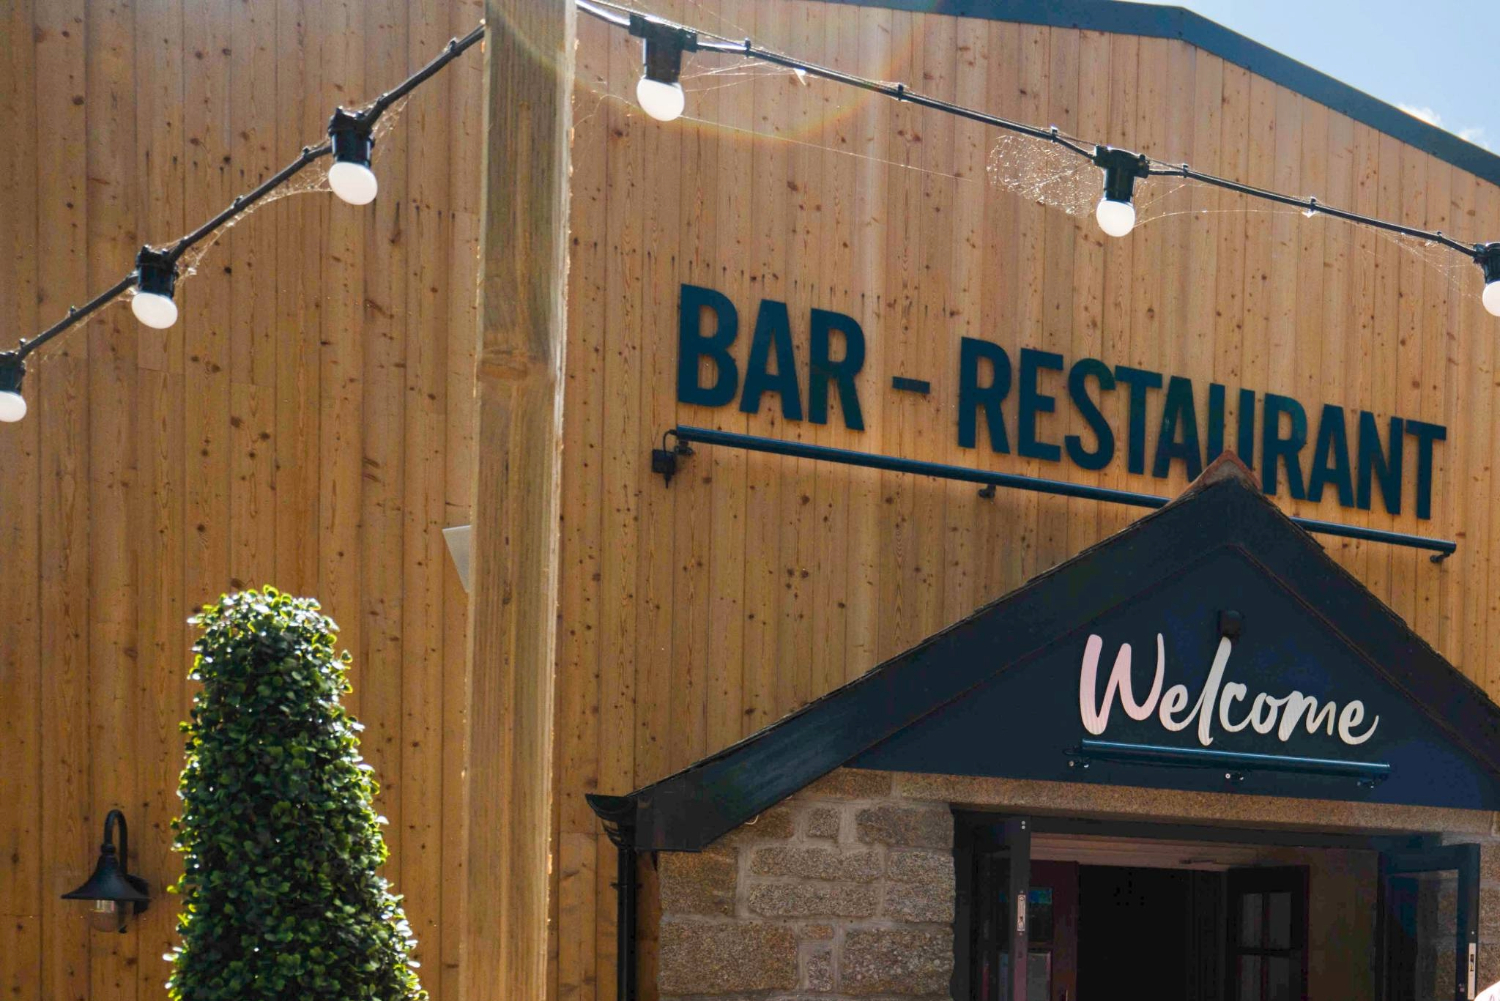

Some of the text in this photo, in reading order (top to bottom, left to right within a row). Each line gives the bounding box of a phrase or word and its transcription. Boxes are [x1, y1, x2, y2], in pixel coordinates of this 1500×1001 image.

[677, 284, 866, 431] BAR
[957, 336, 1447, 520] RESTAURANT
[1080, 632, 1379, 746] Welcome
